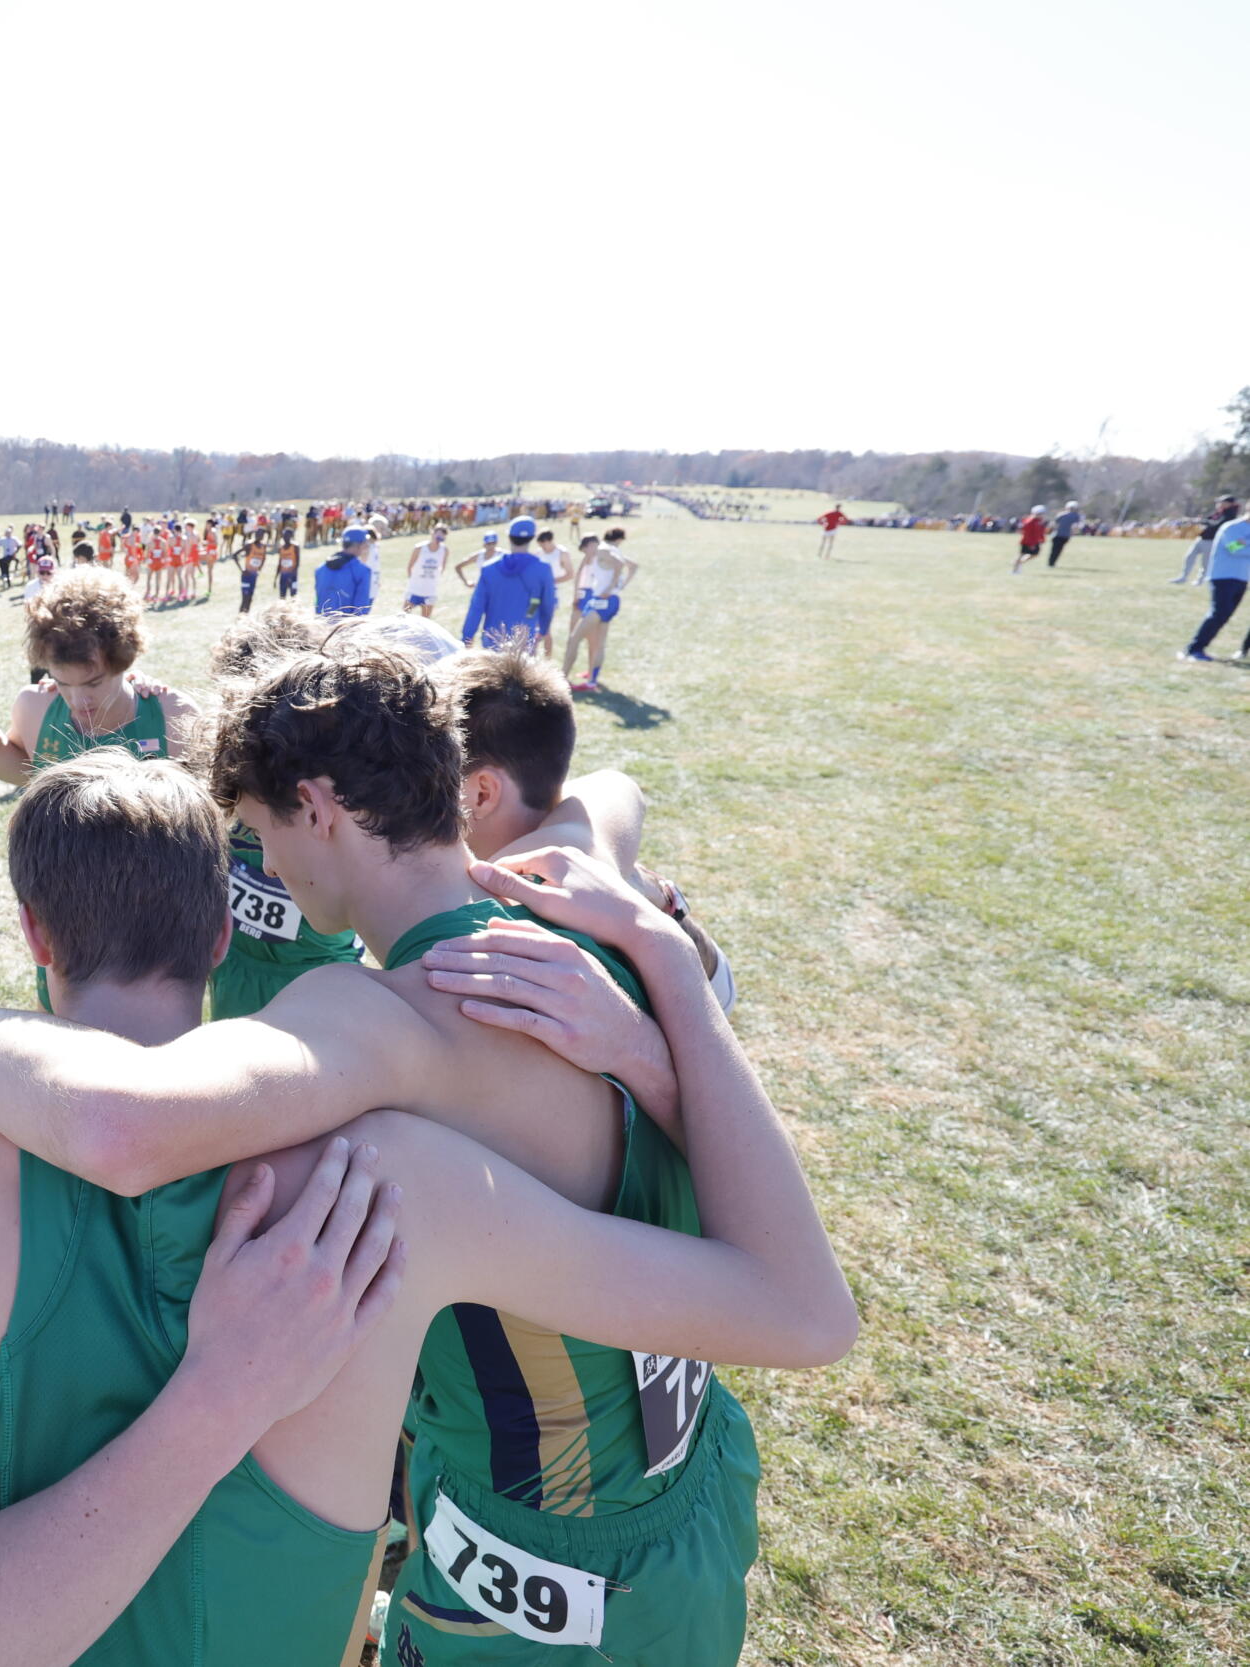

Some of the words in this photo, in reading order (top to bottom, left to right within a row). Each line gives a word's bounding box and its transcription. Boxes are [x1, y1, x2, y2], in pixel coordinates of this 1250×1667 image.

[231, 883, 286, 930] 738
[238, 922, 263, 939] BERG
[448, 1522, 569, 1633] 739
